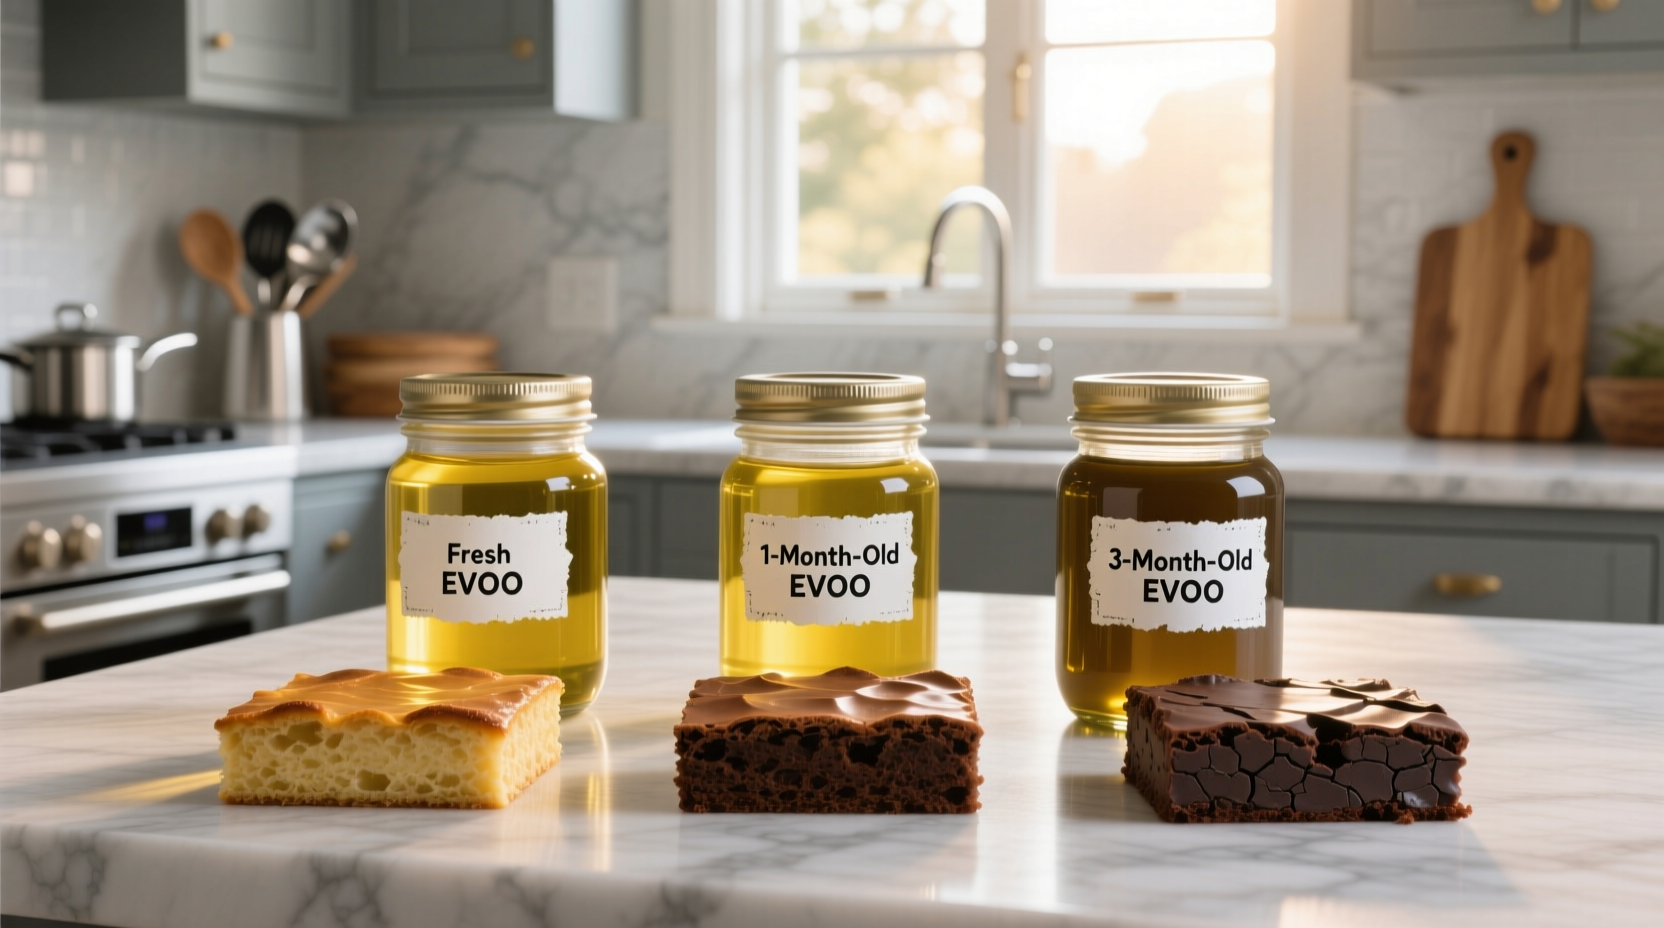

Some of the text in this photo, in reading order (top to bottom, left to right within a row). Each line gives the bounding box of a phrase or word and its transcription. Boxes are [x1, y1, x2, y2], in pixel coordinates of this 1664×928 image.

[447, 542, 511, 565] Fresh
[760, 542, 899, 567] 1-Month-Old
[1108, 547, 1254, 572] 3-Month-Old
[442, 571, 523, 596] EVOO
[790, 573, 871, 598] EVOO
[1143, 578, 1224, 604] EVOO
